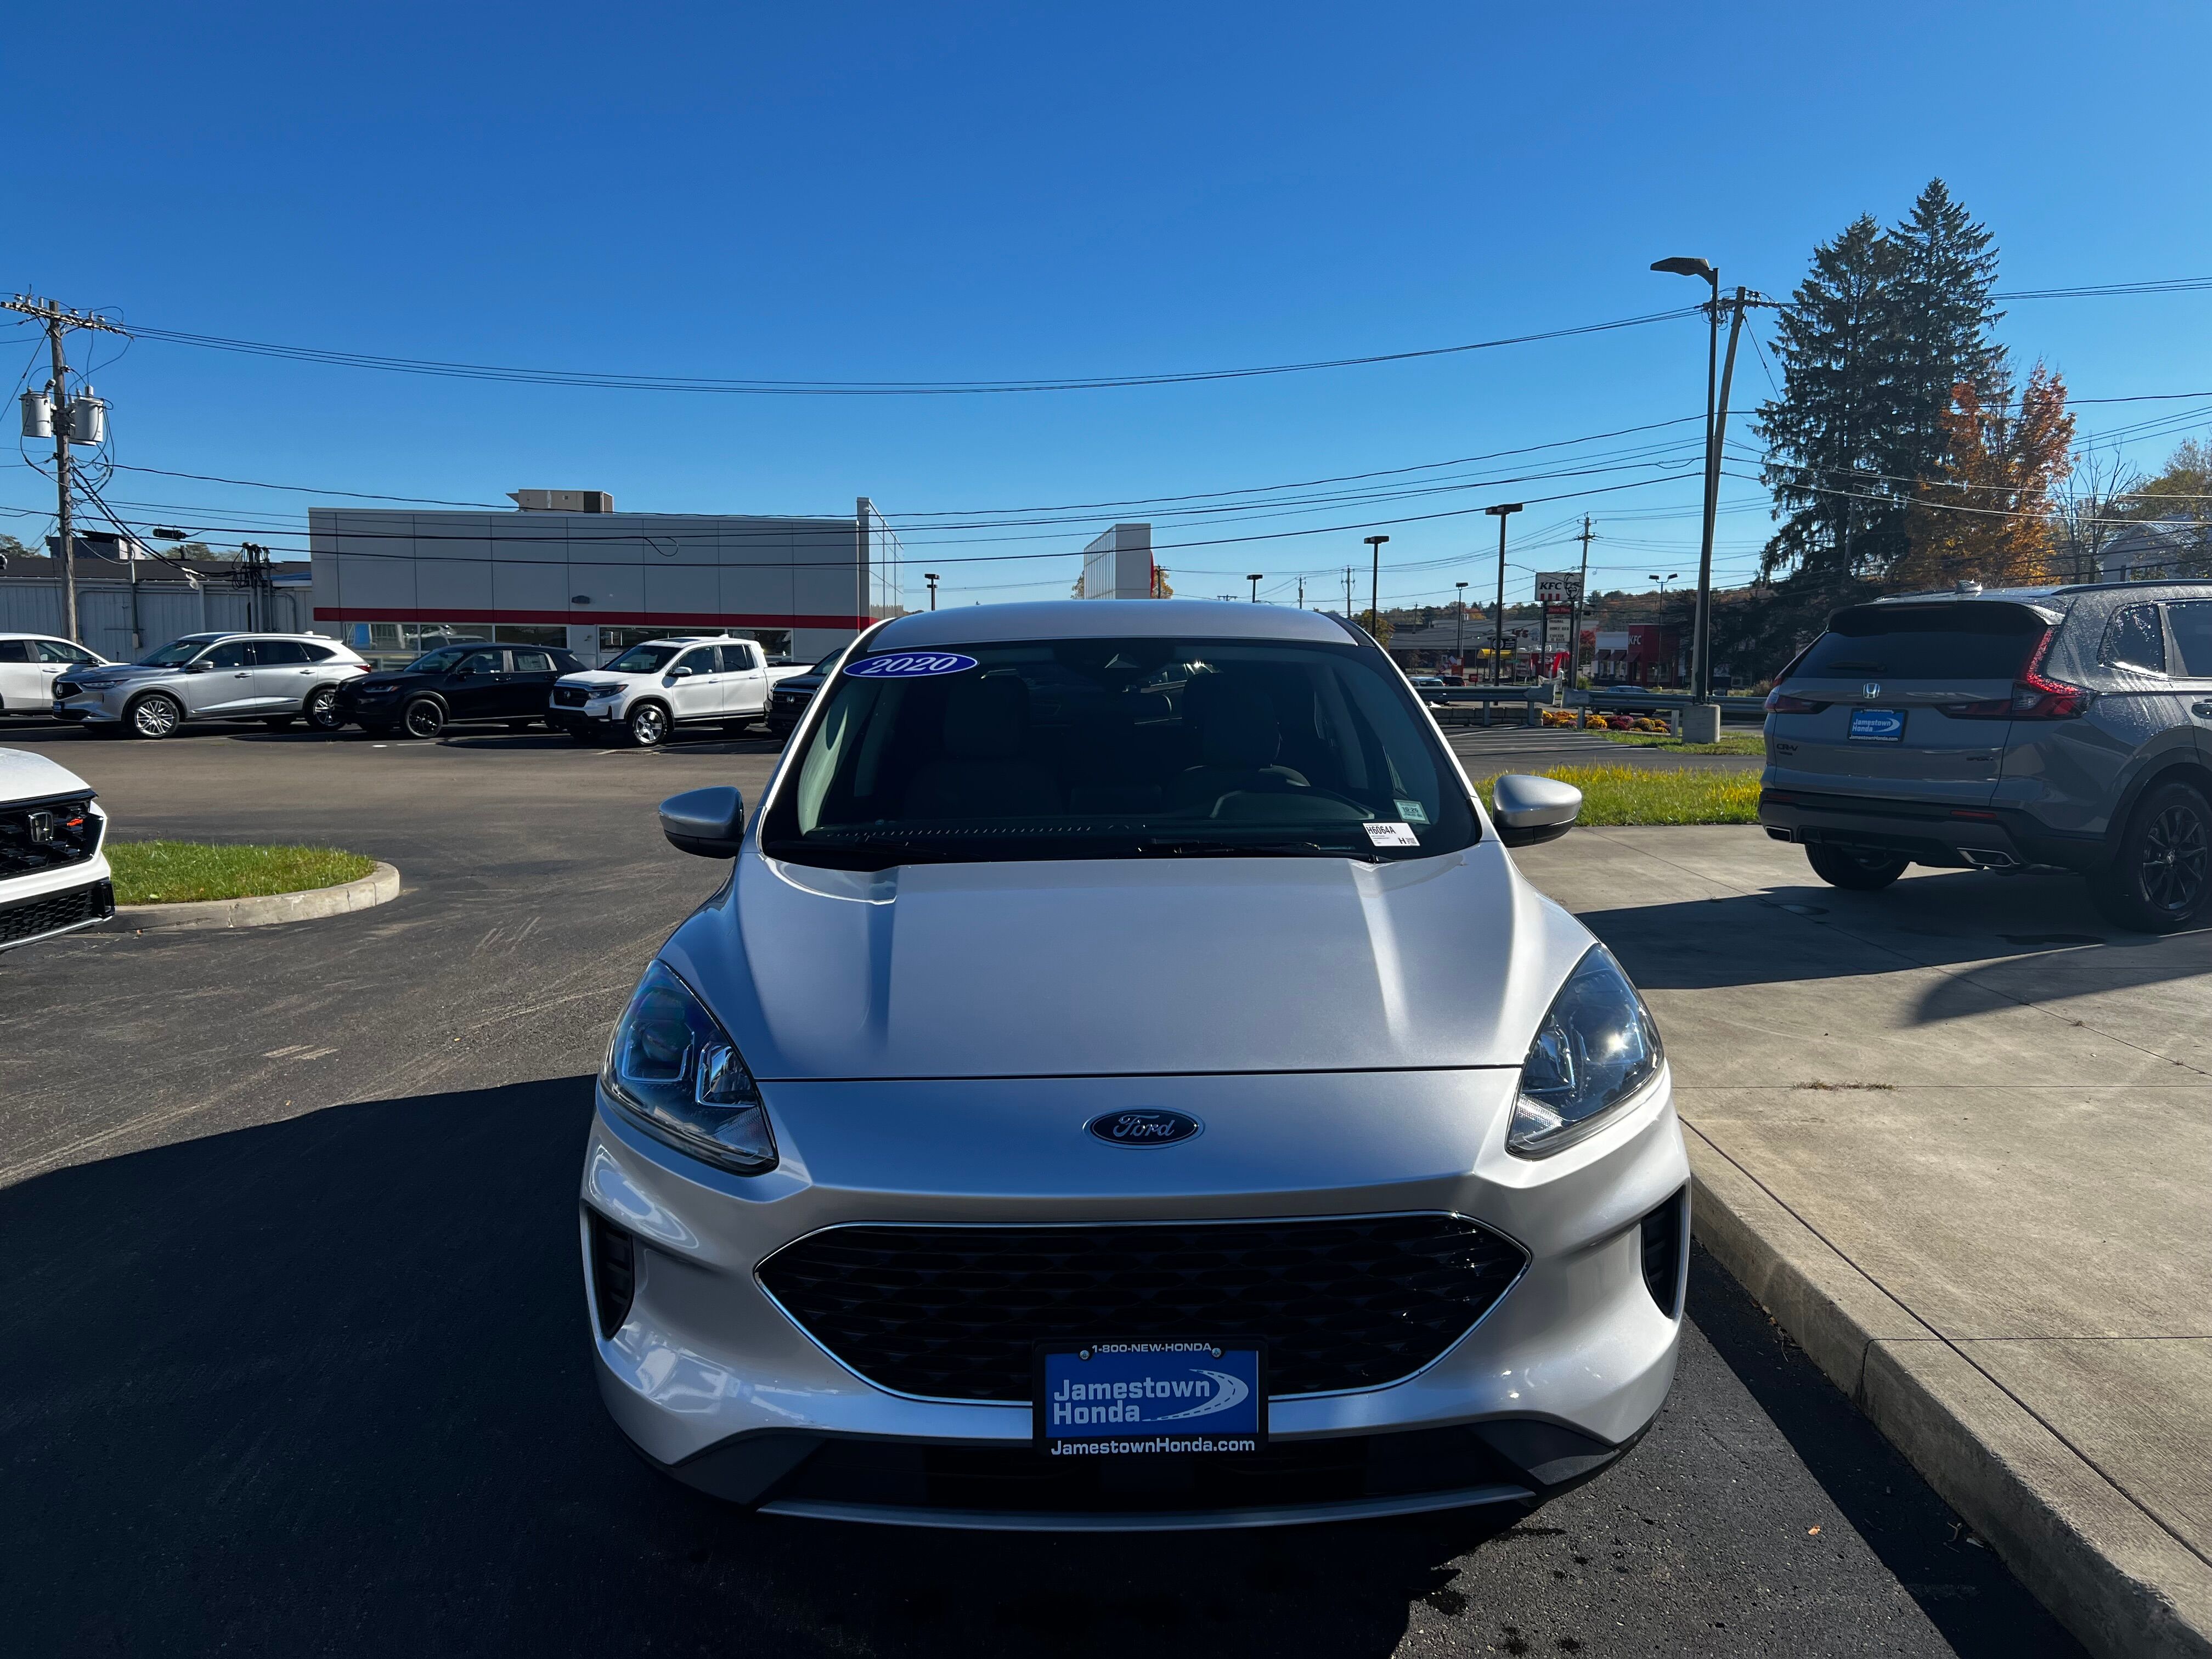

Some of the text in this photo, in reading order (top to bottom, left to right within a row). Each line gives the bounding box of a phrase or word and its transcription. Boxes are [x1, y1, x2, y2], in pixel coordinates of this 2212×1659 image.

[1539, 582, 1562, 590] KFC
[1628, 635, 1642, 645] KFC
[860, 657, 958, 674] 2020
[1853, 718, 1891, 726] Jamestown
[1365, 826, 1396, 834] H6064A
[1113, 1115, 1175, 1137] Ford
[1092, 1342, 1212, 1353] 1-800-NEW-HONDA
[1054, 1377, 1210, 1401] Jamestown
[1053, 1400, 1140, 1425] Honda
[1051, 1437, 1255, 1455] JamestownHonda.com
